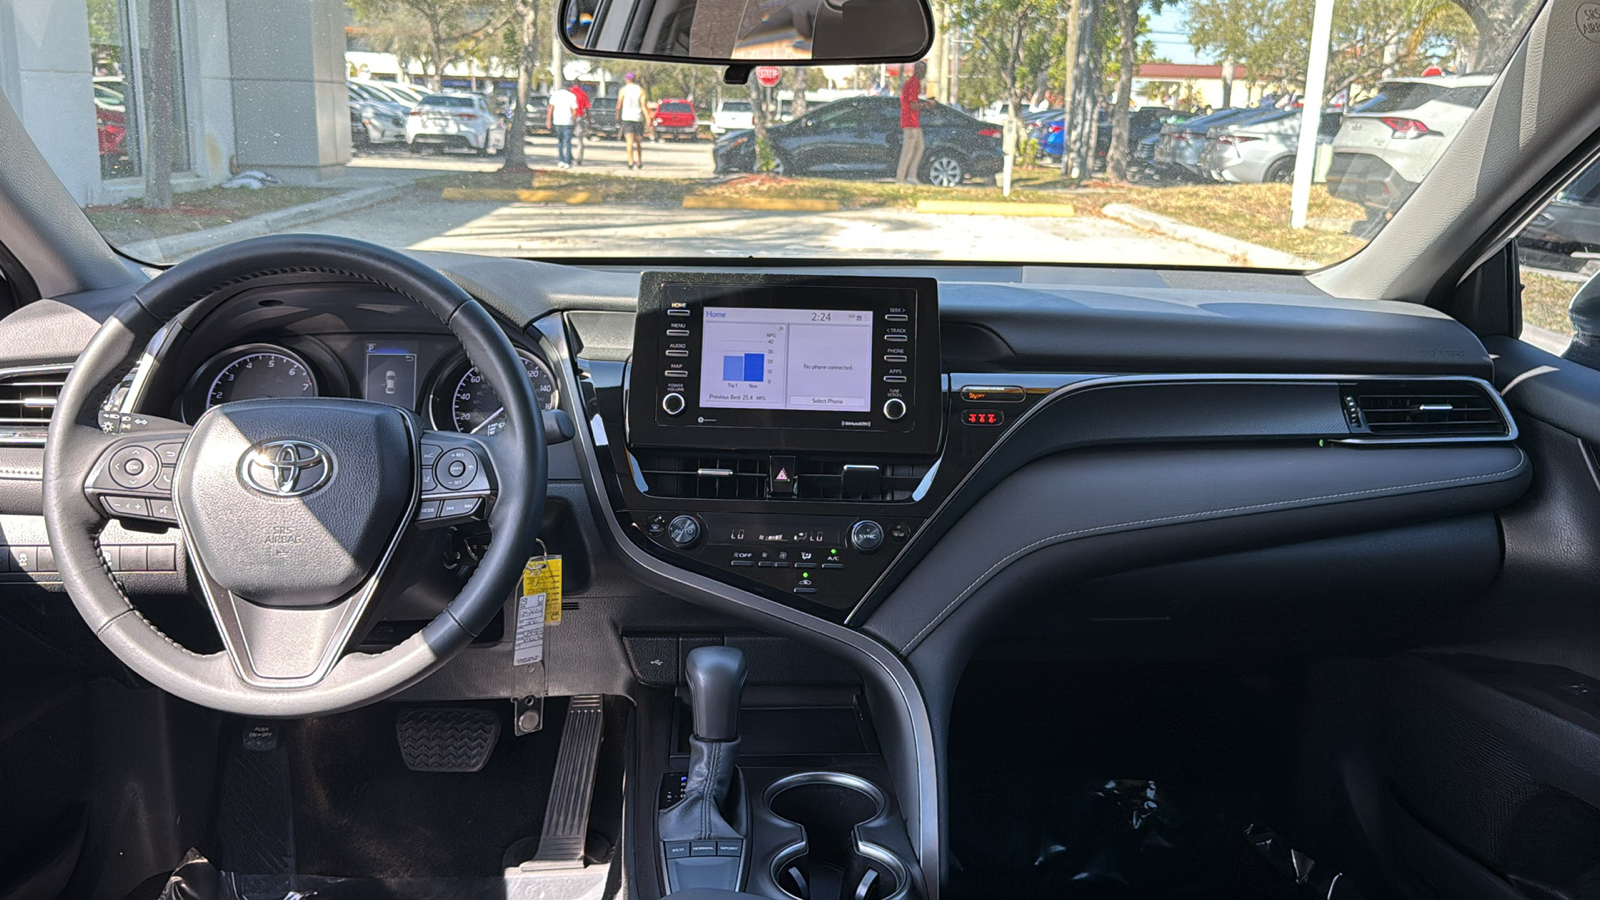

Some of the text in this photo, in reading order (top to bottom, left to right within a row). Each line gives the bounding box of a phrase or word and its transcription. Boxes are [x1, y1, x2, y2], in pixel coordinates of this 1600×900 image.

[759, 69, 778, 78] STOP
[811, 312, 831, 321] 2:24
[302, 383, 309, 391] 7
[273, 526, 293, 534] SRS
[265, 535, 302, 543] AIRBAG
